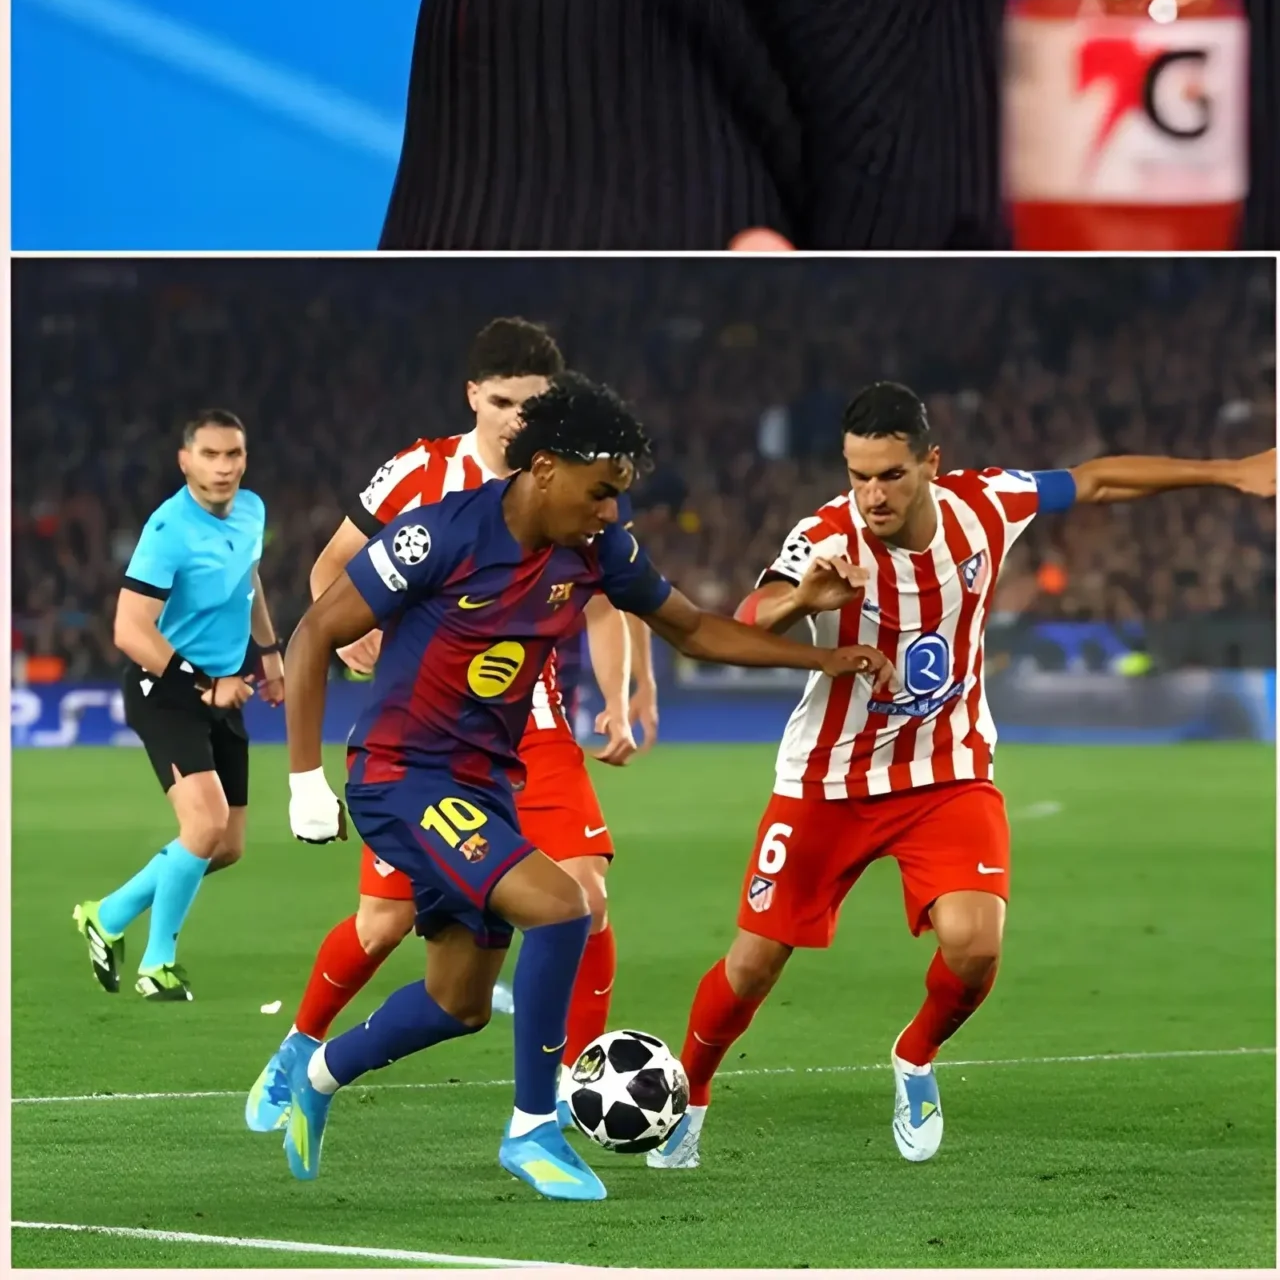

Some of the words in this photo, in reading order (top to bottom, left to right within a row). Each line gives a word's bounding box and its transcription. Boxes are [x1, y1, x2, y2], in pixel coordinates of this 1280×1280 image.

[1143, 49, 1210, 141] G
[420, 797, 488, 849] 10
[757, 821, 794, 875] 6
